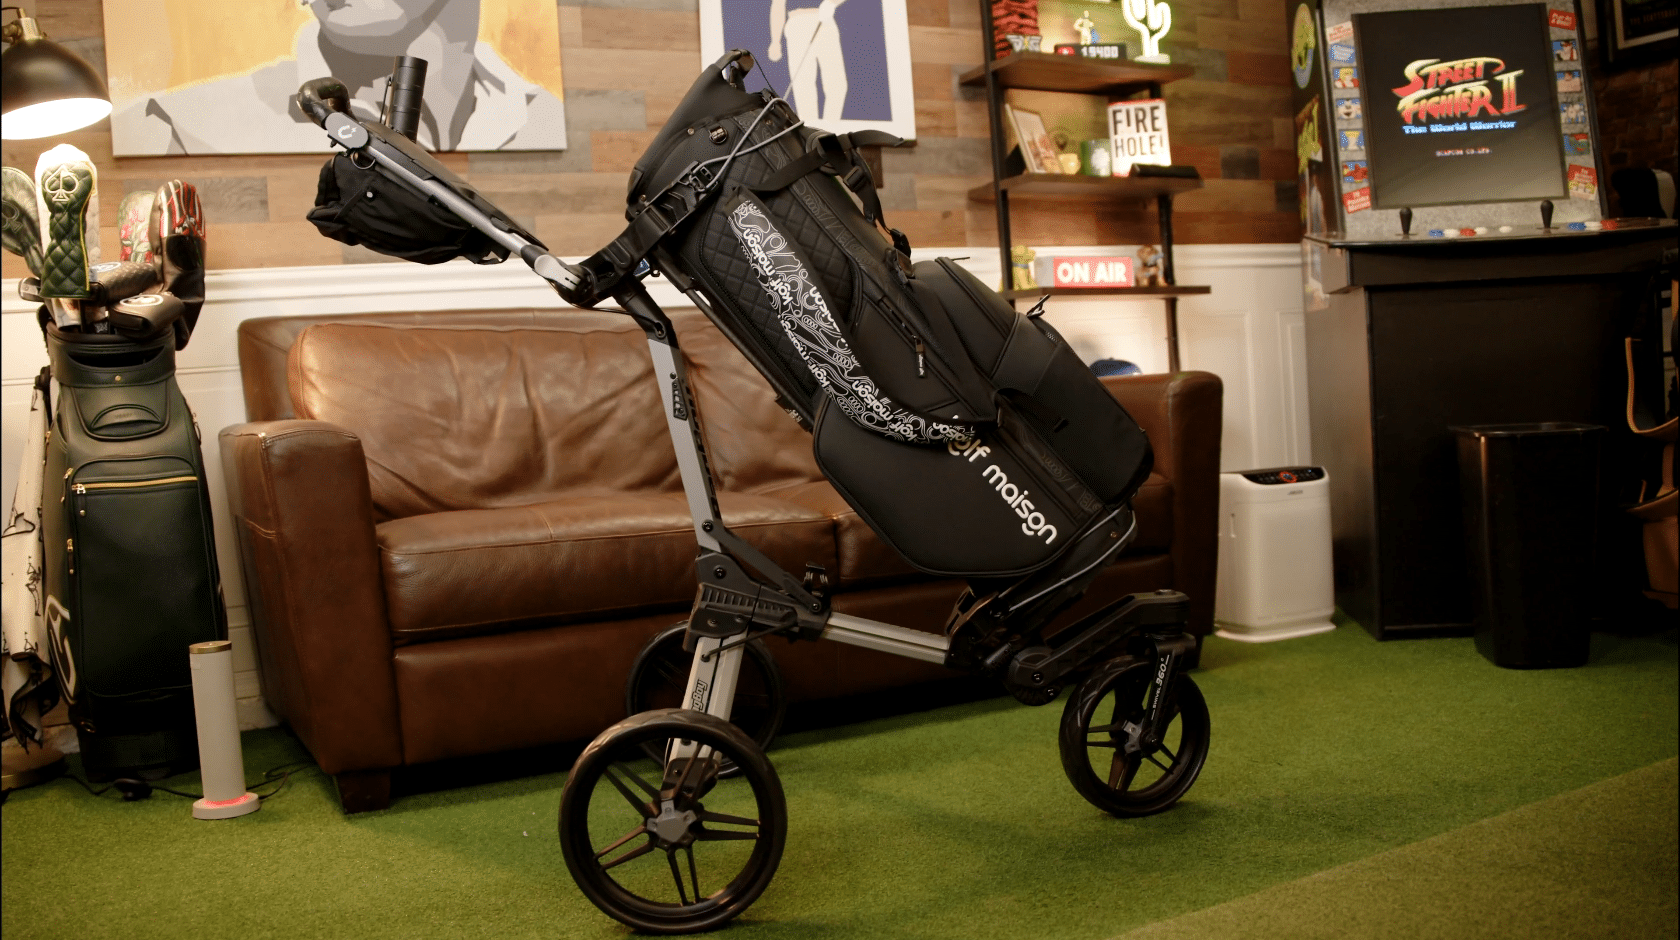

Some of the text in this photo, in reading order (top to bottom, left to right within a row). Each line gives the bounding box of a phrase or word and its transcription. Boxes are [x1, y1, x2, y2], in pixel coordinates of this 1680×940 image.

[1391, 57, 1506, 98] STREET
[1112, 105, 1162, 136] FIRE
[1397, 80, 1501, 125] FIGHTER
[1113, 135, 1165, 158] HOLE!
[743, 228, 776, 277] maison
[1056, 261, 1127, 284] ON AIR
[851, 380, 894, 421] maison
[947, 434, 1058, 545] olf maison
